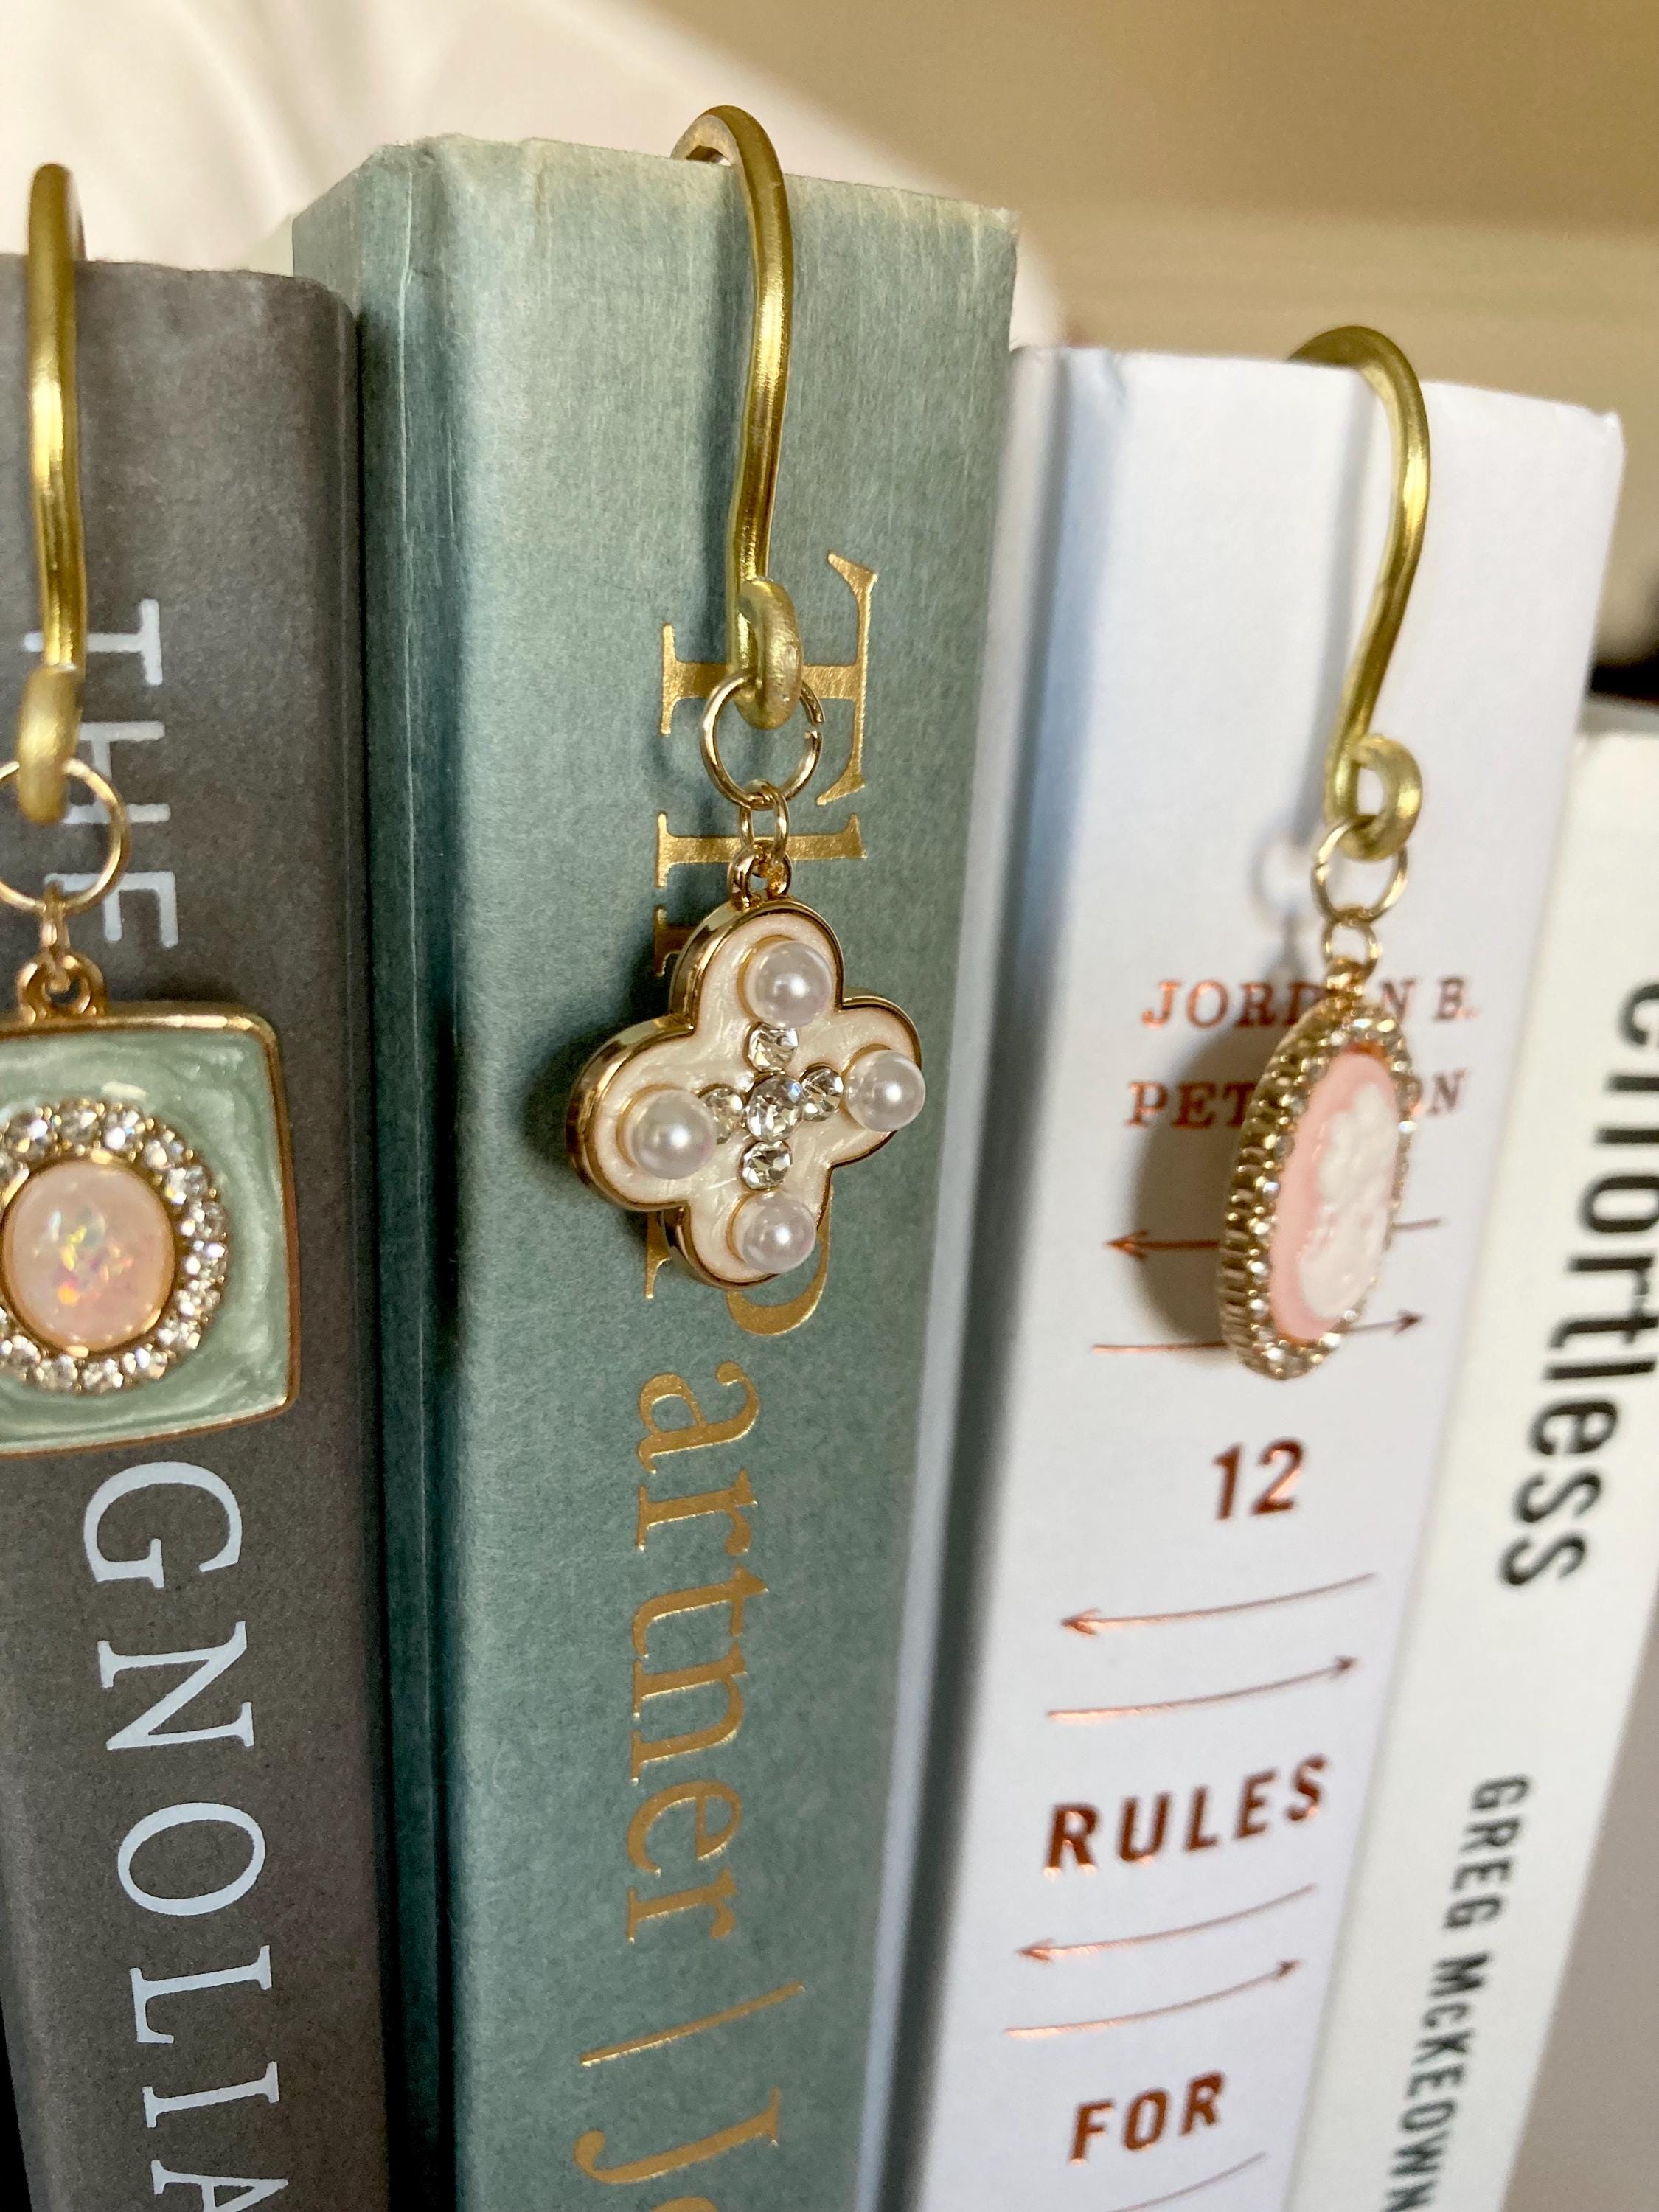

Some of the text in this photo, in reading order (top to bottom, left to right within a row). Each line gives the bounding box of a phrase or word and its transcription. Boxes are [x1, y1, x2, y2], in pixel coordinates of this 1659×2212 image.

[1140, 978, 1416, 1029] JORDN
[1212, 1437, 1306, 1520] 12
[83, 1461, 289, 2212] GNOLIA
[1043, 1753, 1329, 1876] RULES
[1441, 1772, 1531, 1930] GREG
[573, 2087, 782, 2212] J
[1069, 2070, 1227, 2165] FOR
